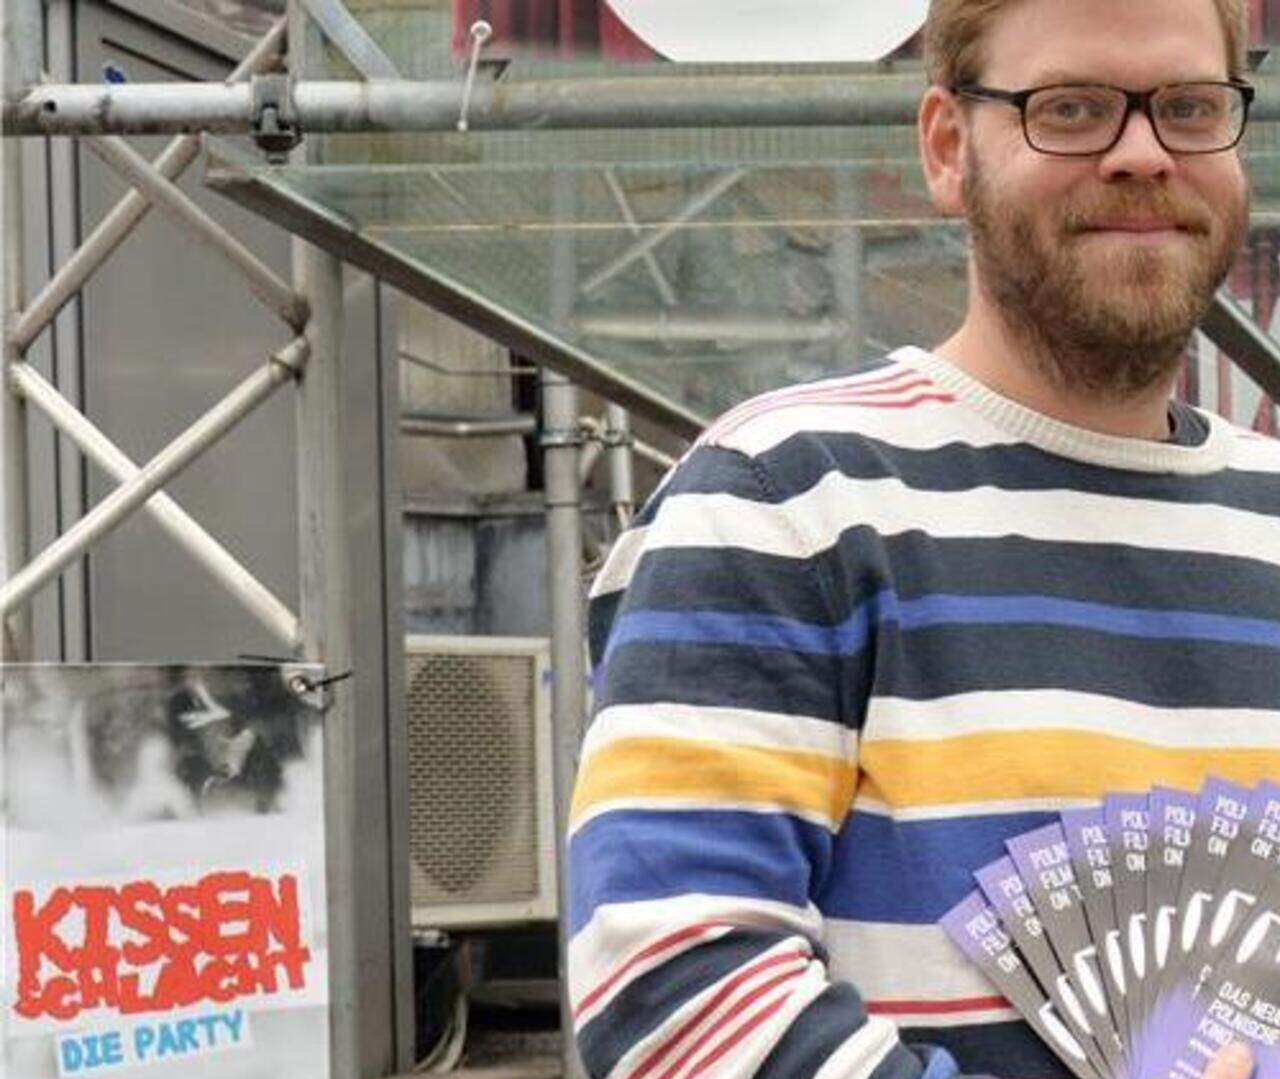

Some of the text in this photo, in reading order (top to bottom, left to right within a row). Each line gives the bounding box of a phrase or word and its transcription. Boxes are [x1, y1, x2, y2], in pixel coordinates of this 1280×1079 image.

[14, 871, 301, 978] KISSEN
[60, 1009, 243, 1071] DIE PARTY
